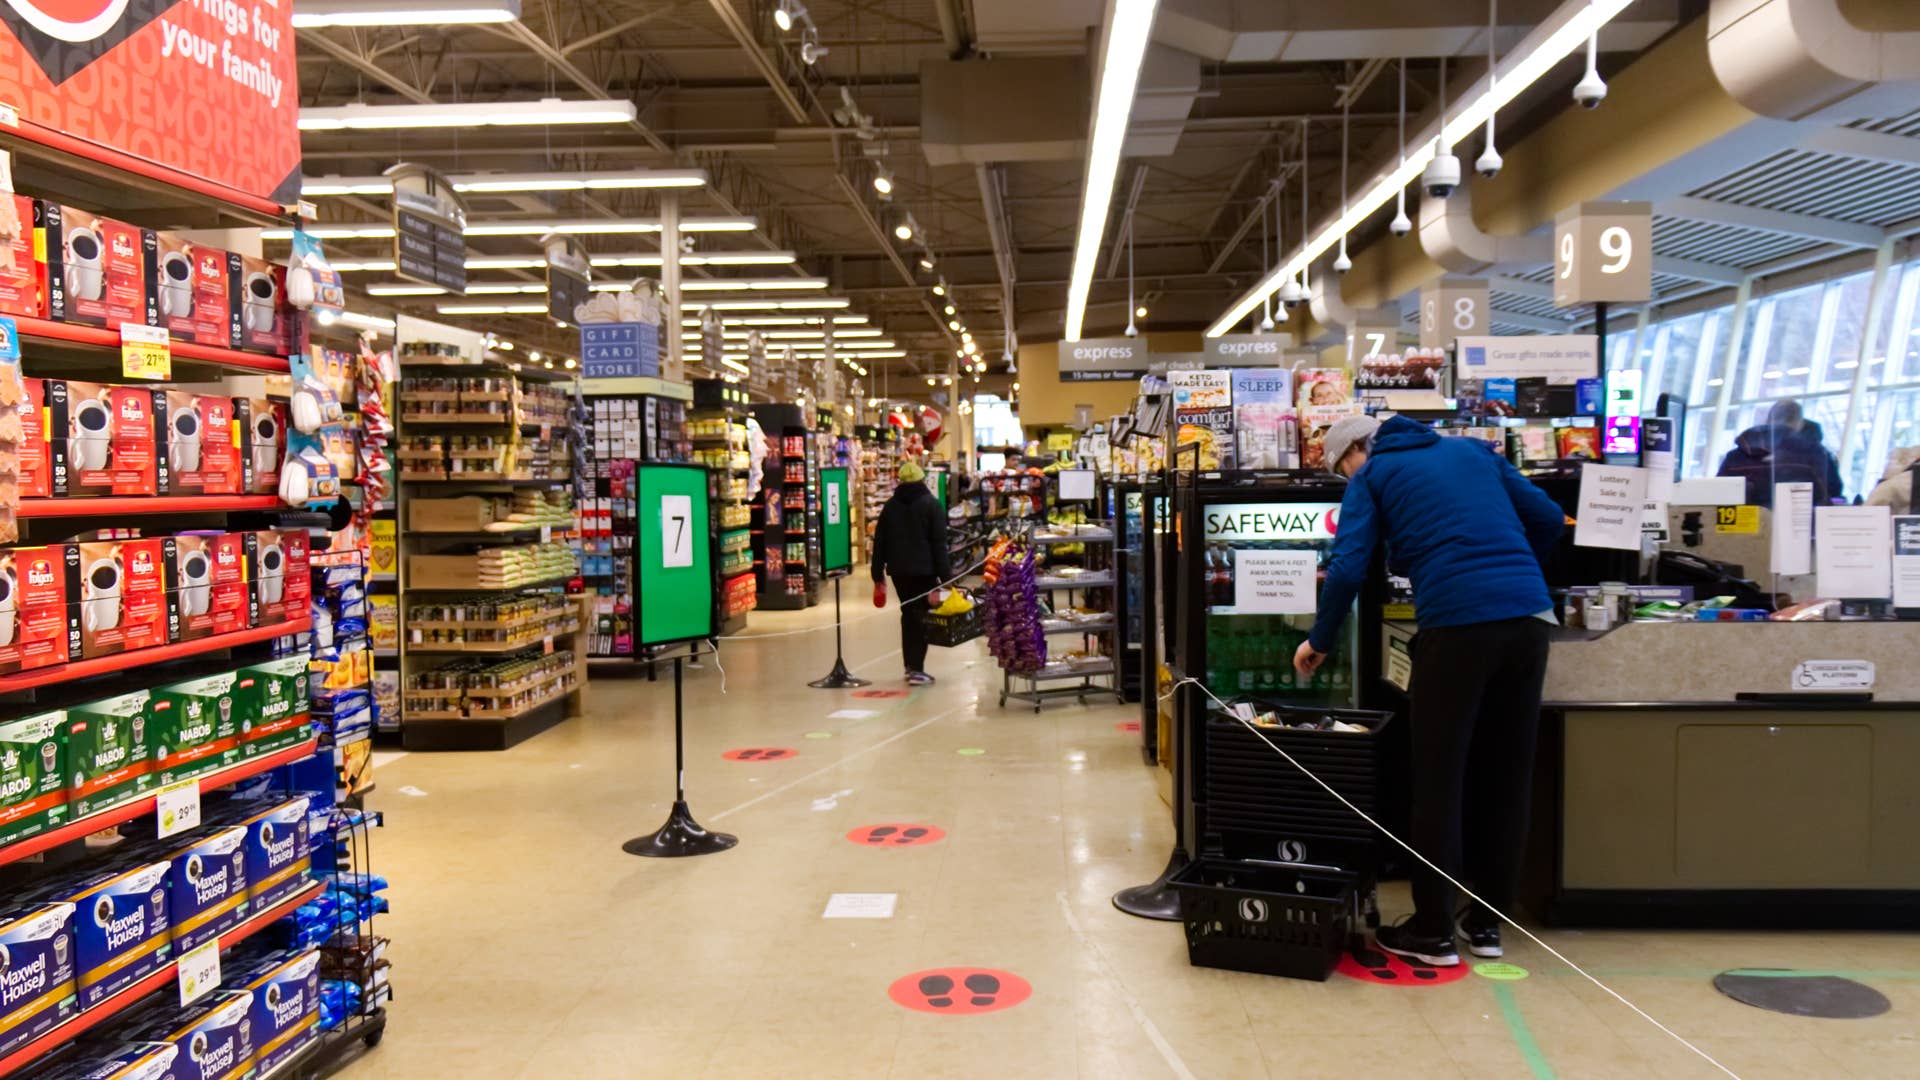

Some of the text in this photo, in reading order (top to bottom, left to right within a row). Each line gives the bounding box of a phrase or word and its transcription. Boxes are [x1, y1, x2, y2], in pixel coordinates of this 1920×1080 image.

[253, 7, 281, 53] for
[161, 19, 282, 108] your family
[1561, 226, 1632, 279] 9 9
[1454, 297, 1475, 330] 8
[587, 330, 633, 341] GIFT
[1366, 334, 1385, 358] 7
[587, 347, 633, 358] CARD
[1073, 346, 1133, 362] express
[1219, 342, 1278, 357] express
[589, 364, 633, 376] STORE
[1239, 381, 1284, 392] SLEEP
[1178, 409, 1233, 425] comfort
[1599, 475, 1630, 485] Lottery
[831, 494, 838, 516] 5
[1590, 502, 1633, 512] temporary
[1718, 507, 1736, 524] 19
[1207, 512, 1319, 534] SAFEWAY
[672, 516, 685, 554] 7
[69, 631, 80, 641] 50
[262, 701, 289, 717] NABOB
[180, 724, 211, 742] NABOB
[95, 747, 125, 768] NABOB
[268, 833, 294, 857] Maxwell
[269, 850, 292, 868] House
[195, 865, 227, 892] Maxwell
[197, 883, 224, 905] House
[105, 904, 145, 937] Maxwell
[108, 927, 140, 951] House
[0, 953, 46, 991] Maxwell
[3, 976, 40, 1006] House
[274, 988, 302, 1015] Maxwell
[200, 1035, 234, 1067] Maxwell
